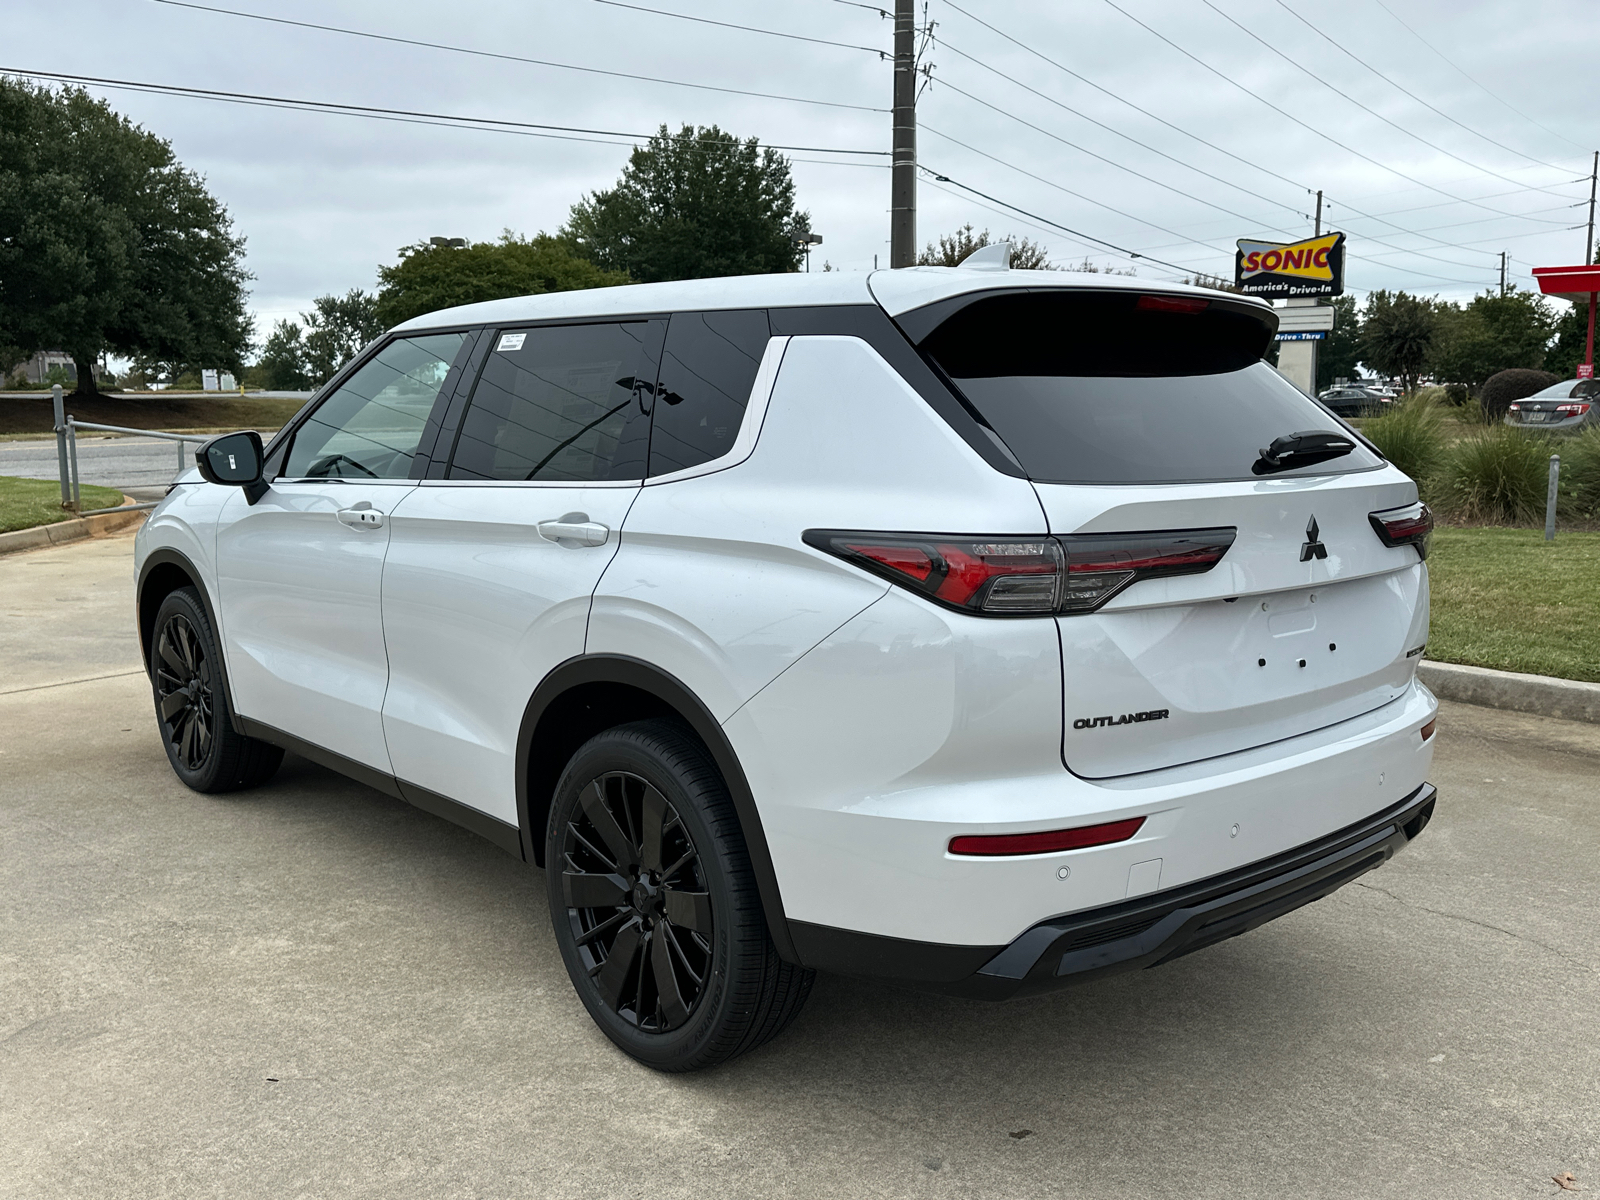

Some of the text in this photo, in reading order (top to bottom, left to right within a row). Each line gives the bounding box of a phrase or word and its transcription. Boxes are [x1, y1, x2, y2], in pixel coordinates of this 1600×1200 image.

[1244, 247, 1331, 272] SONIC
[1242, 282, 1289, 293] America's
[1073, 709, 1170, 730] OUTLANDER
[693, 985, 723, 1045] COUNTRY
